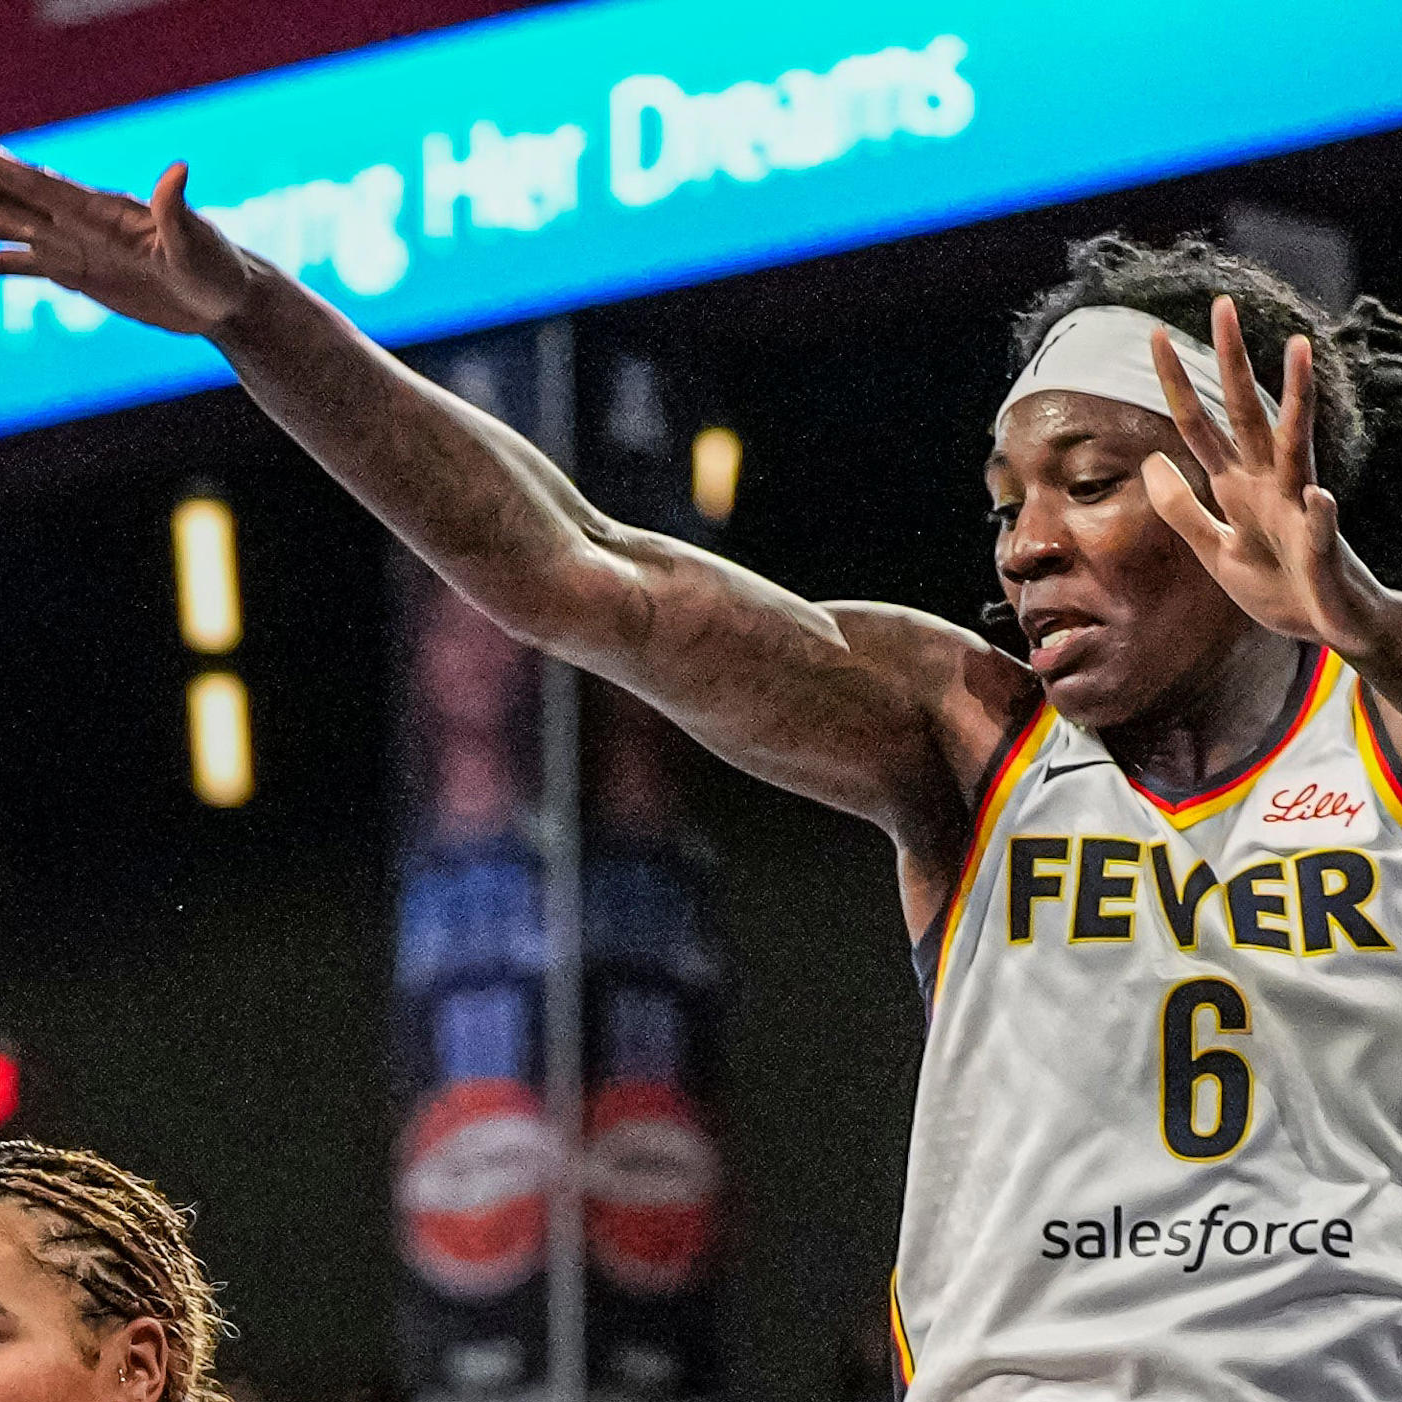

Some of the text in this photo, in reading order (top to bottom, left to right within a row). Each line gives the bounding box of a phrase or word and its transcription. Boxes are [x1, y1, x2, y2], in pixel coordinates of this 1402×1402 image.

[422, 120, 587, 234] Her
[610, 34, 976, 206] Dreams
[1263, 783, 1366, 827] Lilly
[1006, 835, 1397, 958] FEVER
[1159, 975, 1254, 1164] 6
[1041, 1204, 1354, 1273] salesforce
